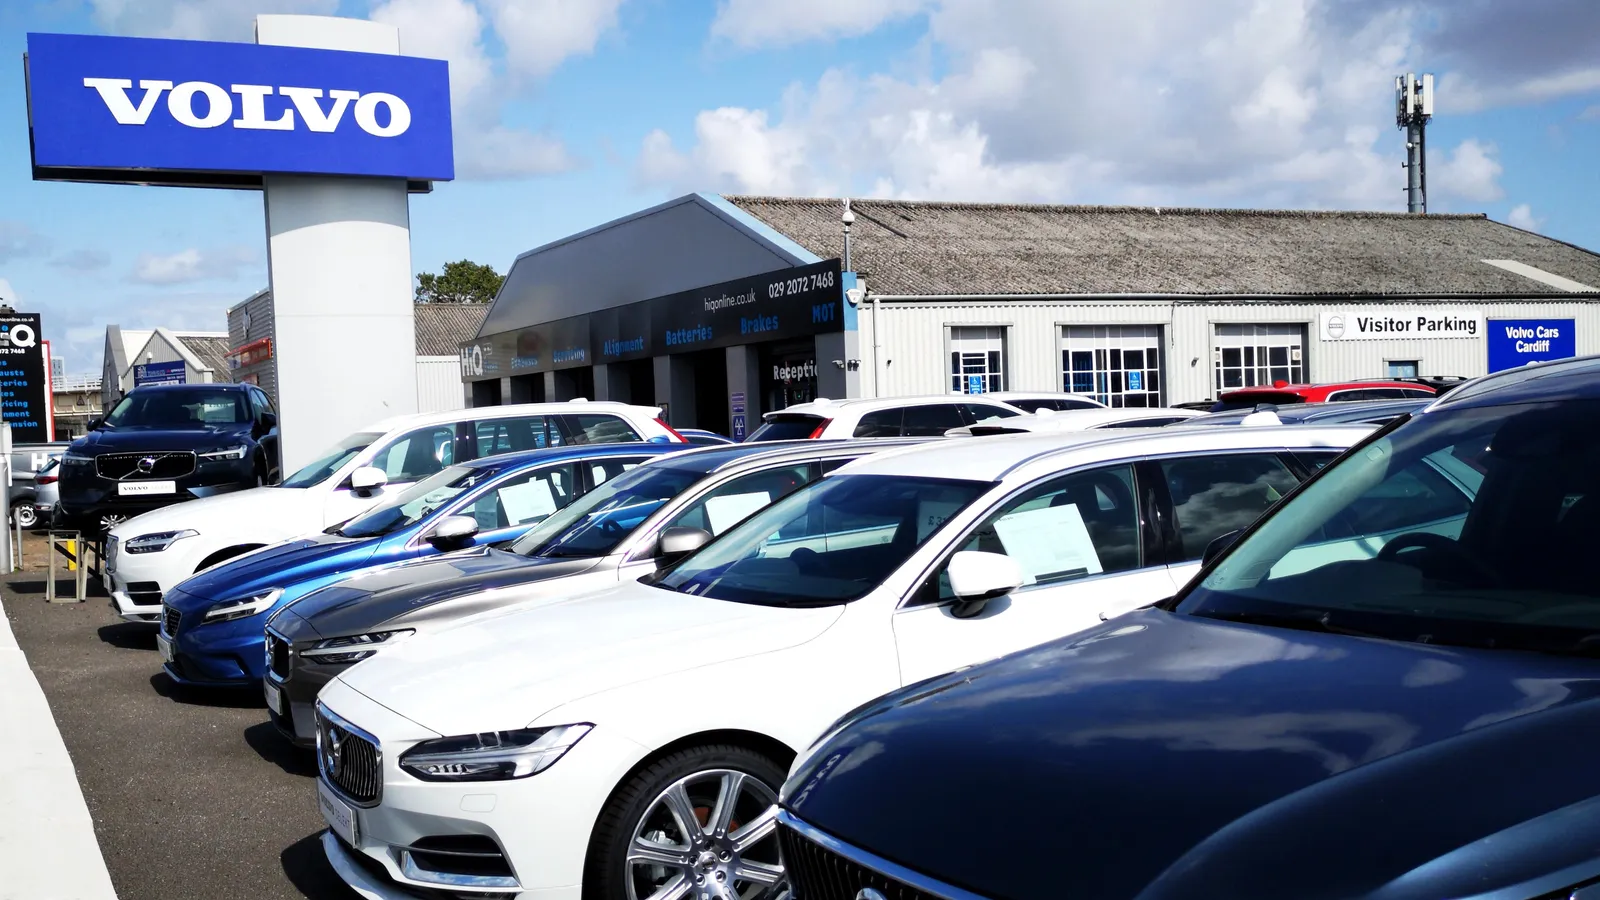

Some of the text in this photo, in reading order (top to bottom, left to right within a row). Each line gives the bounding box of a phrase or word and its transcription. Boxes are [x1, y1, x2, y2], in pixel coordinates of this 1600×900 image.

[83, 77, 411, 137] VOLVO
[704, 271, 834, 313] hiqonline.co.uk 029 2072 7468
[812, 302, 835, 323] MOT
[665, 324, 712, 346] Batteries
[741, 314, 778, 335] Brakes
[1357, 316, 1476, 334] Visitor Parking
[1505, 326, 1559, 339] Volvo Cars
[603, 336, 644, 356] Alignment
[1516, 340, 1550, 353] Cardiff
[460, 344, 483, 376] HiQ
